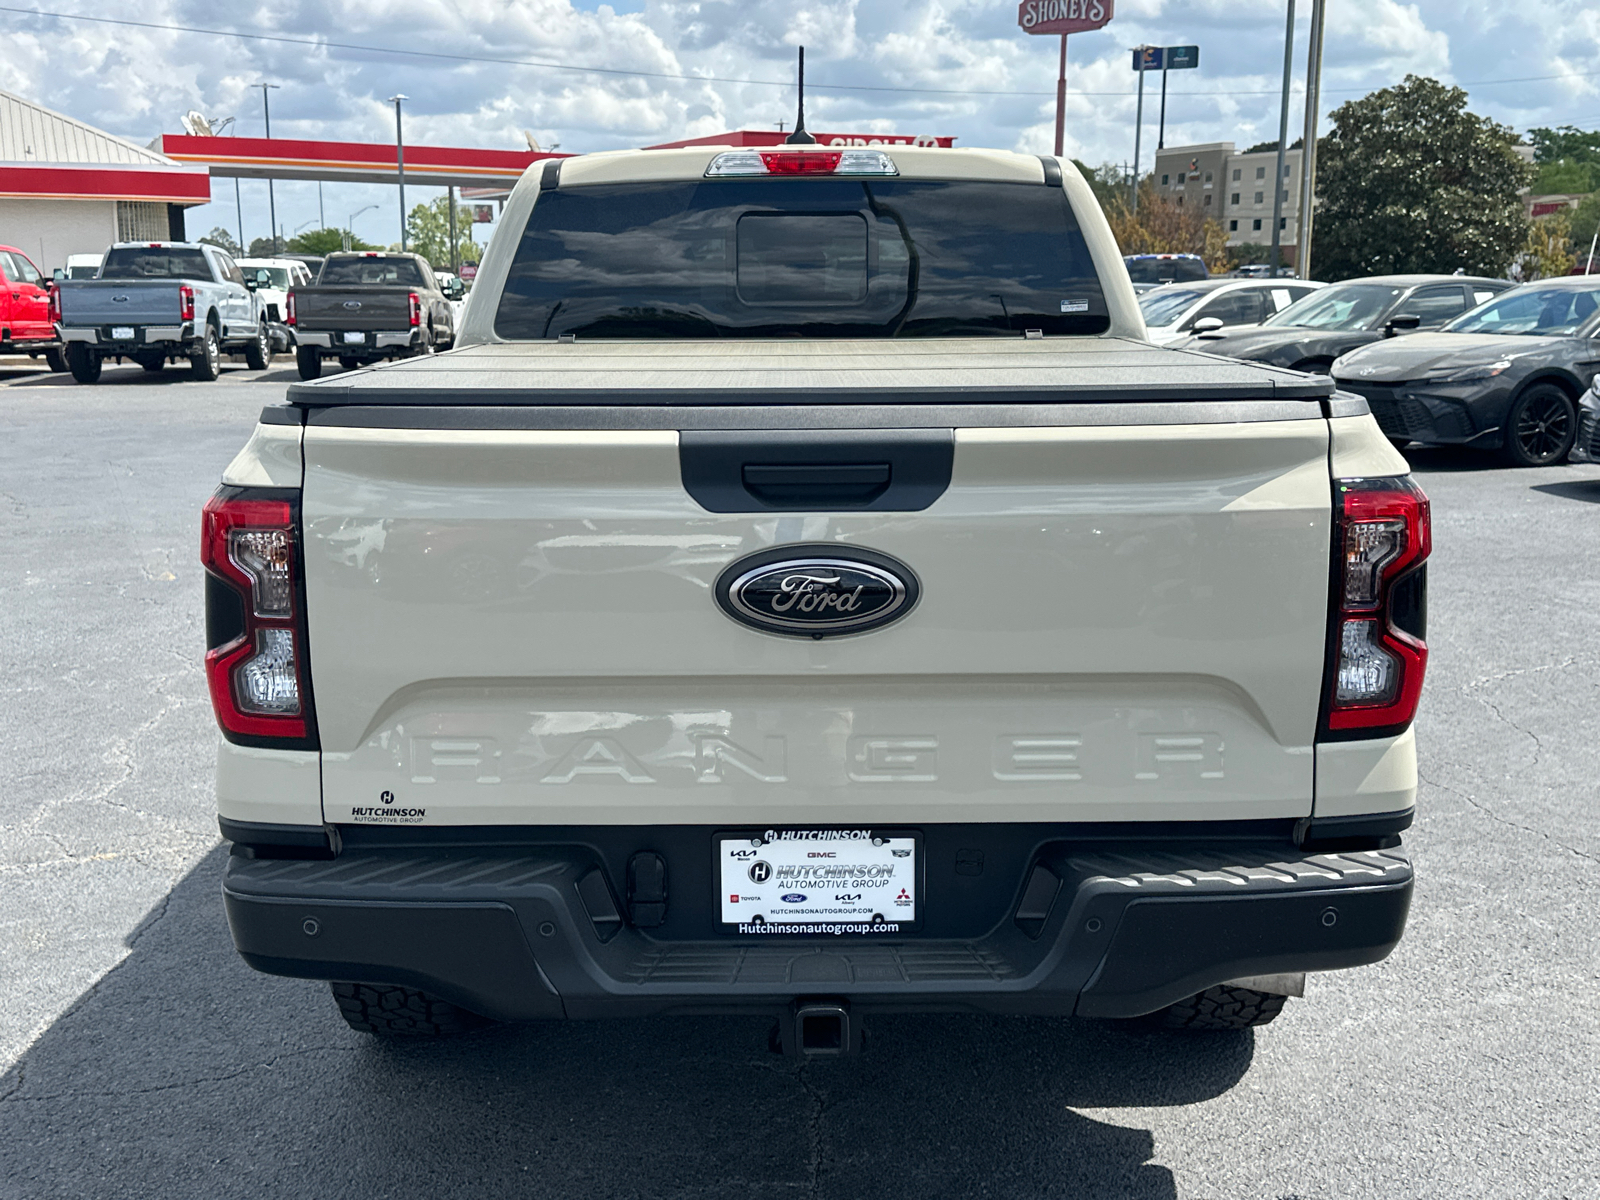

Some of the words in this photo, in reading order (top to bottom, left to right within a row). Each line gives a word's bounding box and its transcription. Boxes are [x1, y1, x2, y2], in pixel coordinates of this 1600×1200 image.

[1023, 0, 1104, 27] SHONEY'S
[771, 574, 864, 612] Ford
[410, 732, 1226, 784] RANGER
[352, 807, 426, 817] HUTCHINSON
[780, 829, 872, 841] HUTCHINSON
[776, 864, 895, 879] HUTCHINSON
[778, 880, 848, 889] AUTOMOTIVE
[851, 880, 889, 889] GROUP
[785, 894, 803, 902] Ford
[739, 923, 900, 935] Hutchinsonautogroup.com
